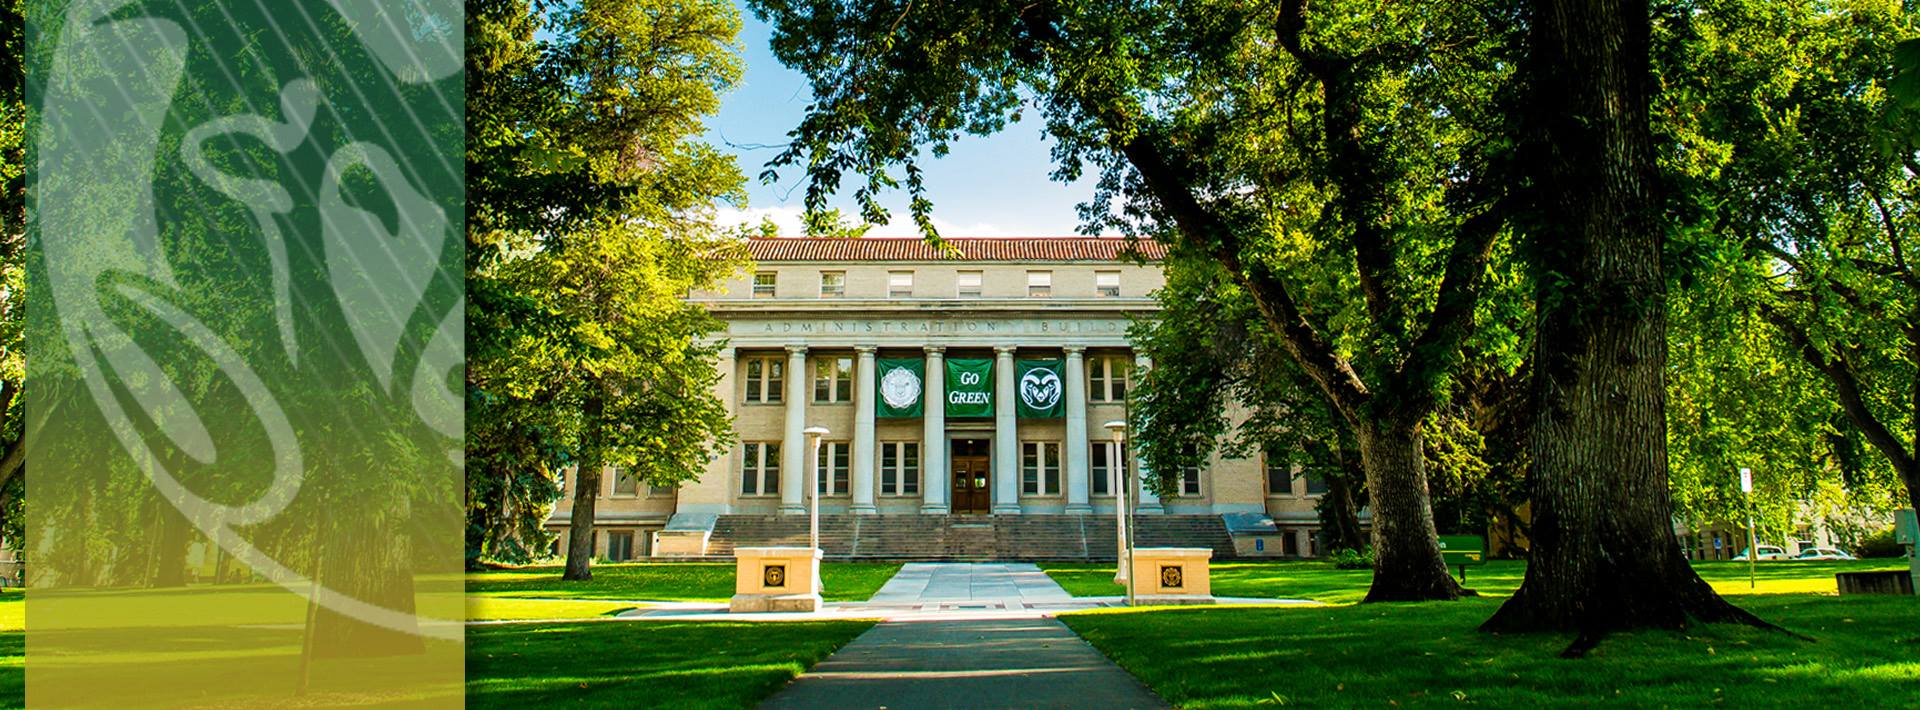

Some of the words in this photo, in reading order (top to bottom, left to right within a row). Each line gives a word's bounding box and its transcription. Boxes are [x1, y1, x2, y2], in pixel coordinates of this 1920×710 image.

[764, 321, 997, 332] ADMINISTRATION
[1041, 321, 1117, 332] BUILD
[960, 371, 980, 385] GO
[948, 390, 991, 404] GREEN
